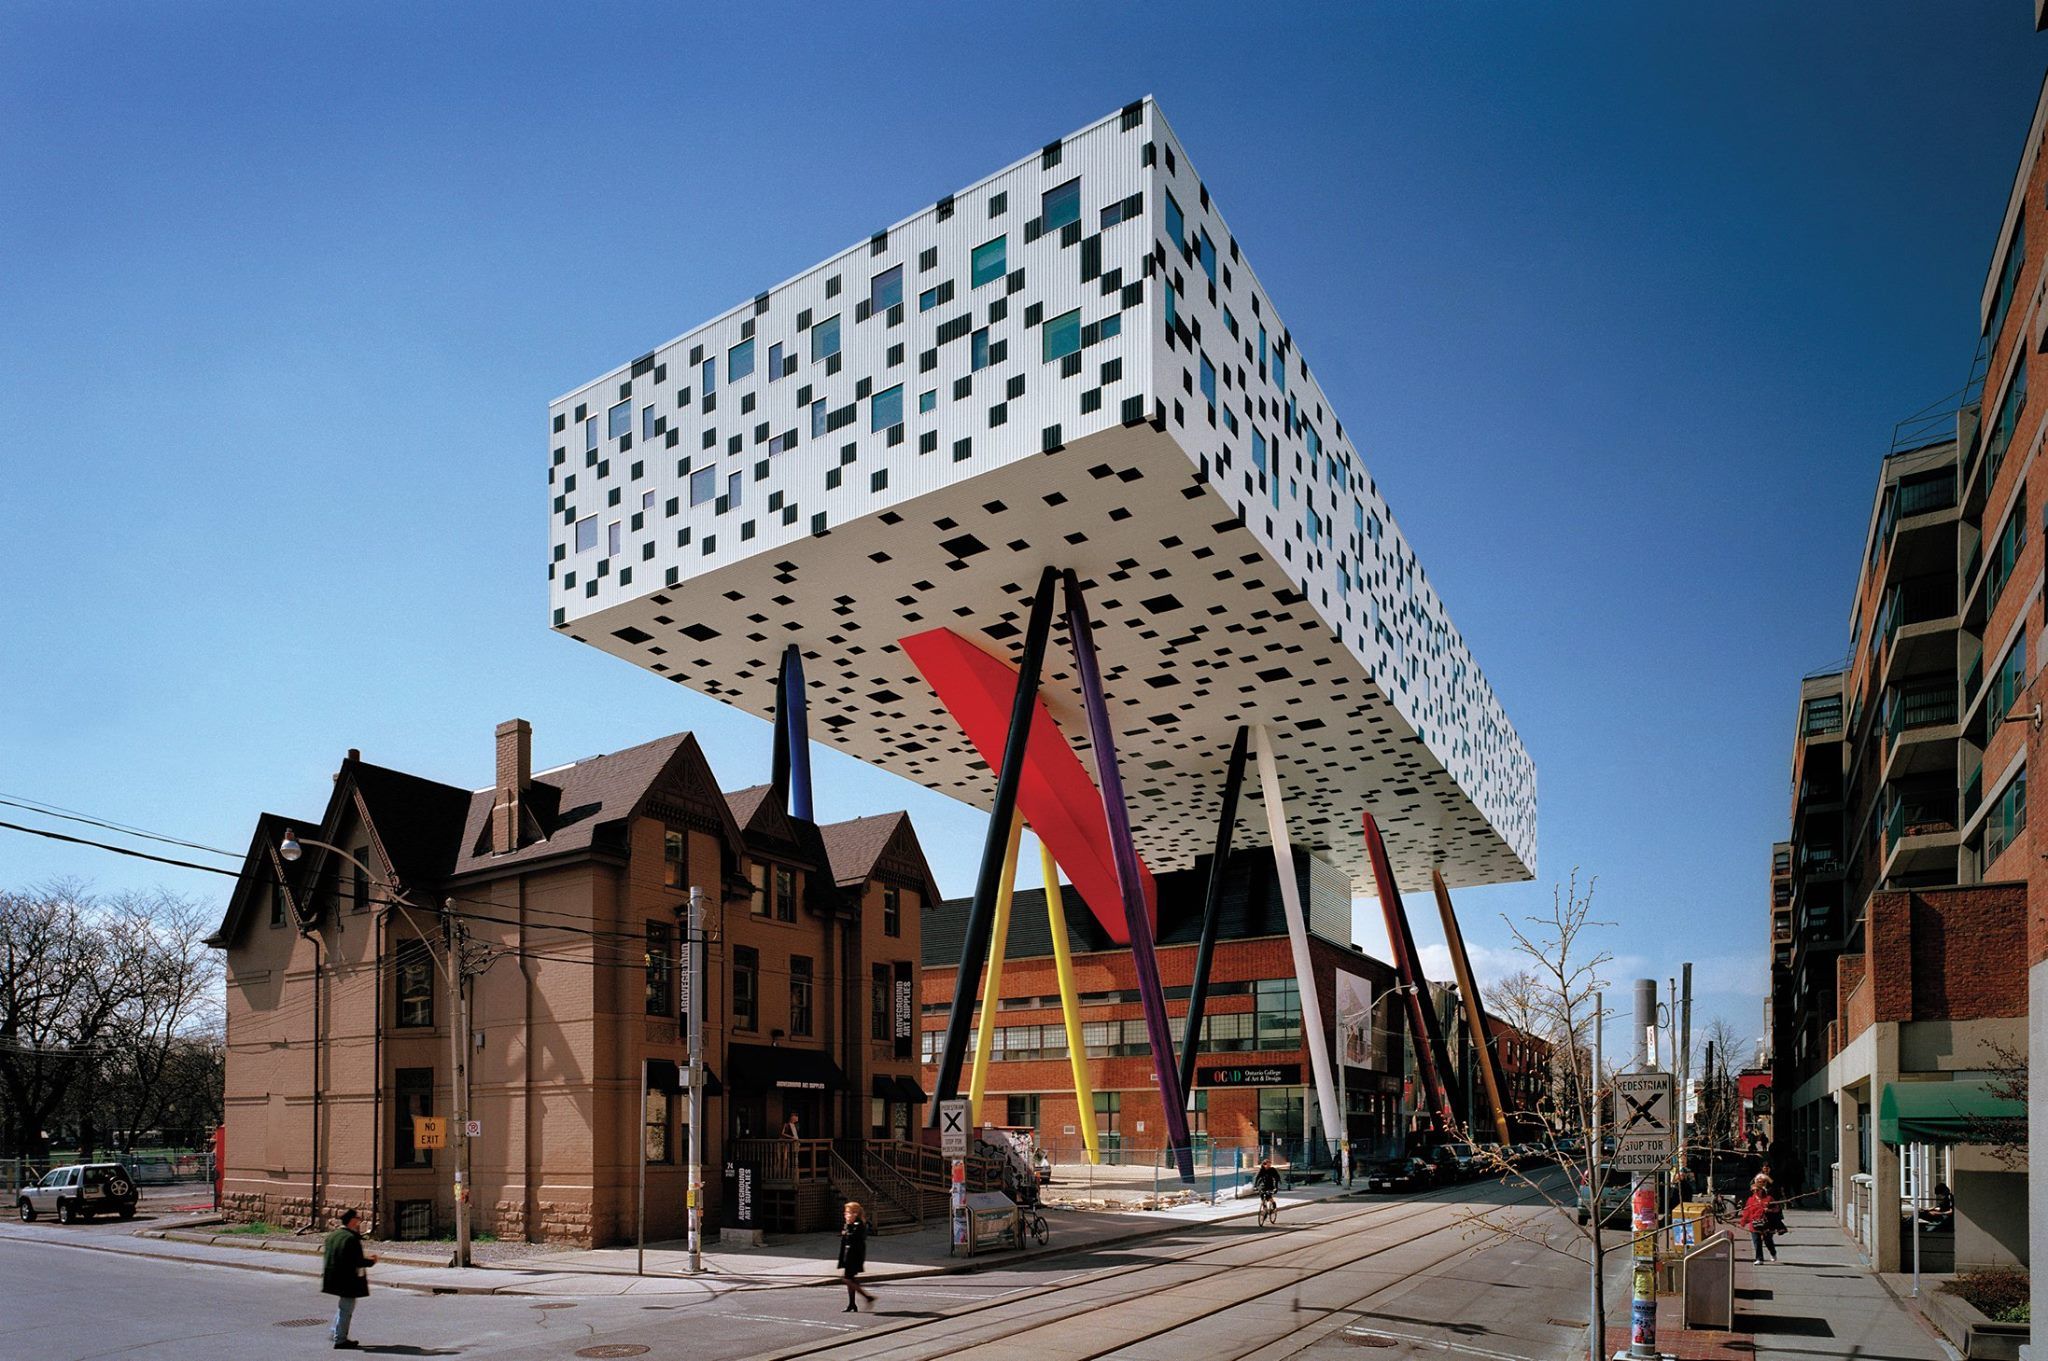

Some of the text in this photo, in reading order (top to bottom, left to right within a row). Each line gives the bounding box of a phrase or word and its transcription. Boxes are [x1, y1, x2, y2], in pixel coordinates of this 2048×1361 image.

[896, 980, 904, 1038] ABOVEGROUND
[903, 981, 911, 1037] ART SUPPLIES
[1618, 1080, 1668, 1091] PEDESTRIAN
[425, 1122, 436, 1131] NO
[421, 1135, 439, 1145] EXIT
[1625, 1141, 1663, 1151] STOP FOR
